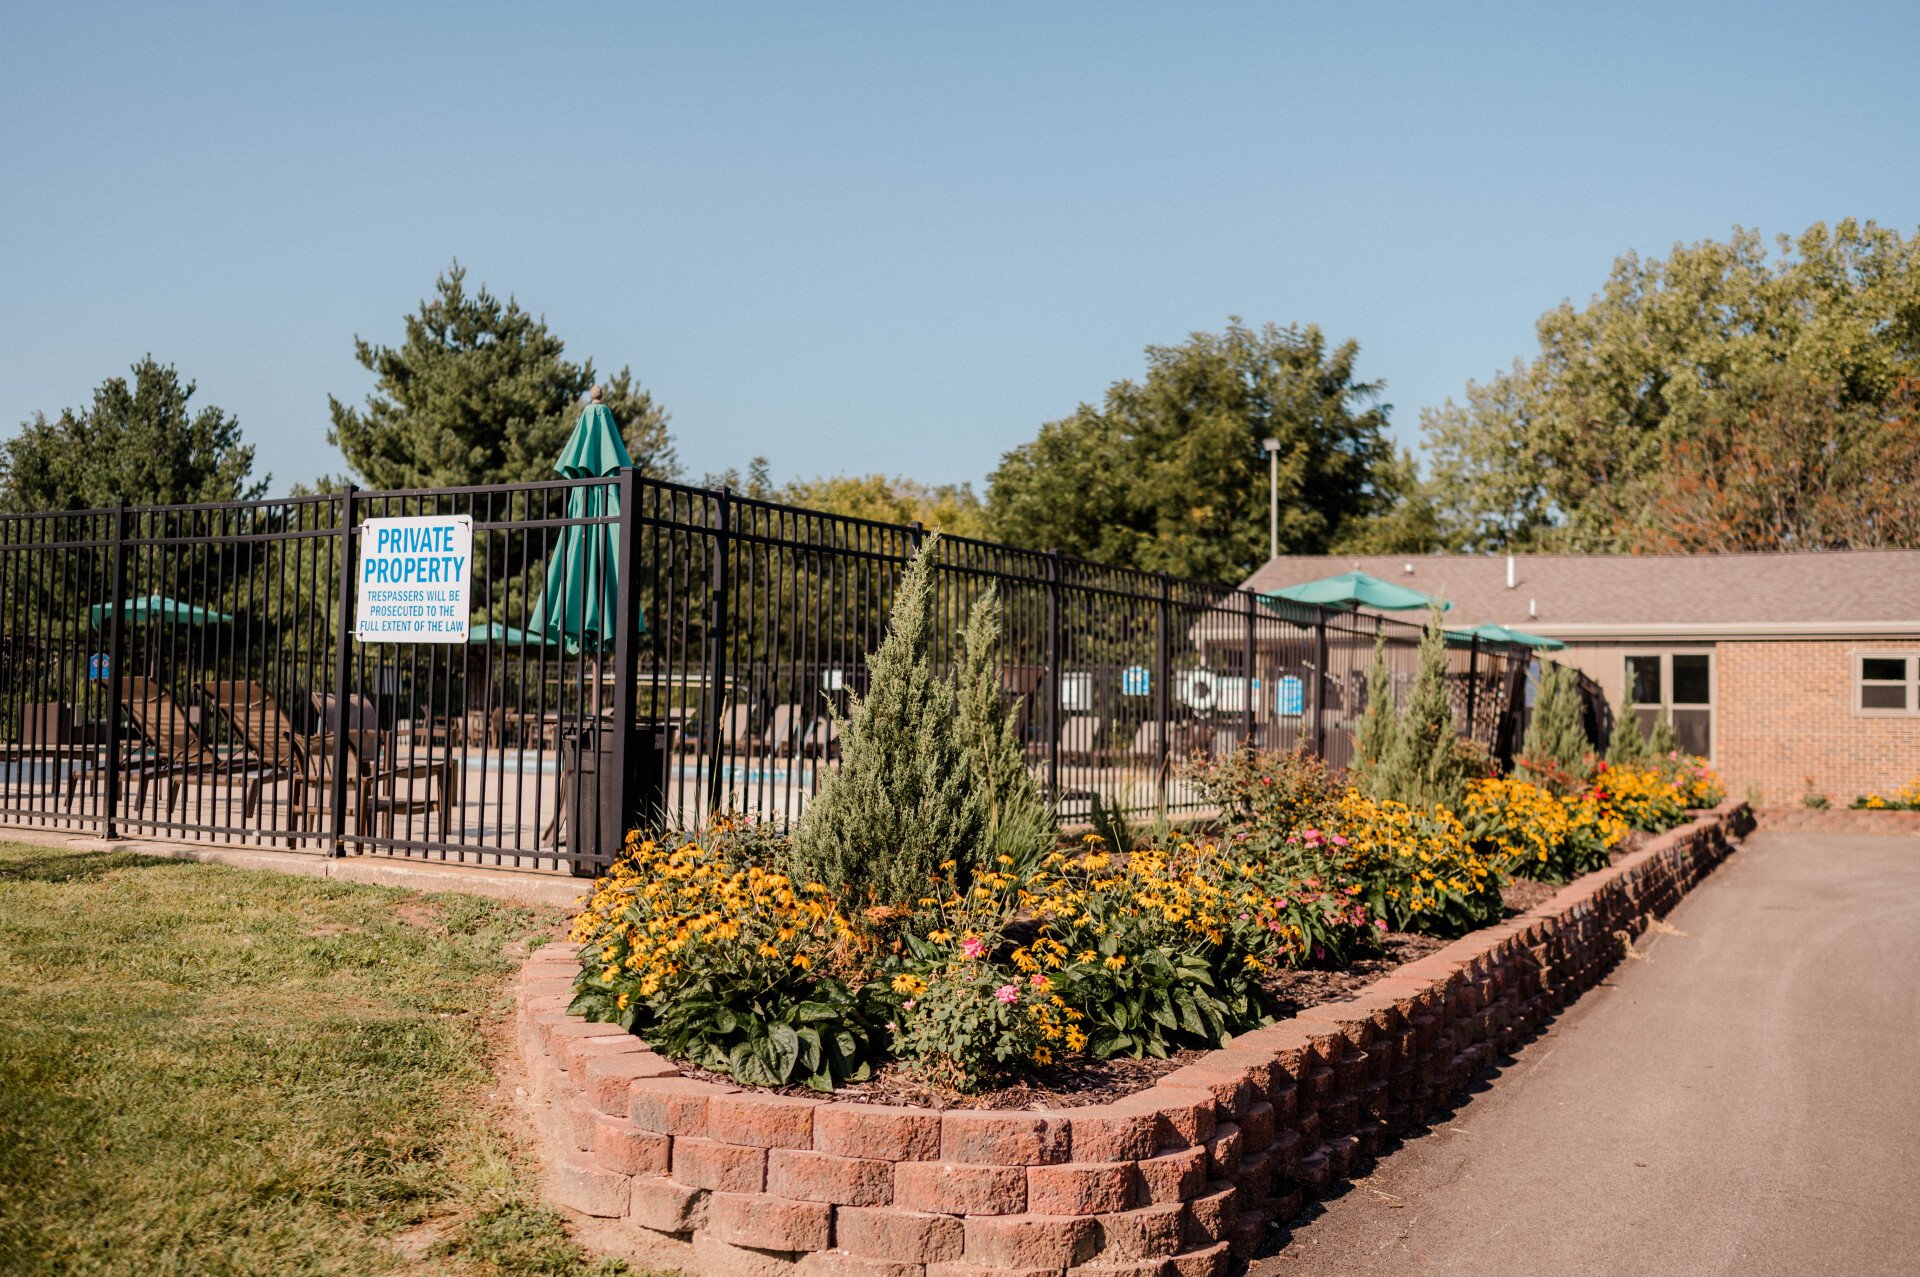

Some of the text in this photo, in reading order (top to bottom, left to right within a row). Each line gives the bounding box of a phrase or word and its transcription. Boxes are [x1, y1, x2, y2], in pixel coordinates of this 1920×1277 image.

[378, 527, 454, 553] PRIVATE
[365, 557, 465, 583] PROPERTY
[368, 590, 460, 601] TRESPASSERS WILL BE
[370, 606, 455, 616] PROSECUTED TO THE
[360, 621, 464, 631] FULL EXTENT OF THE LAW
